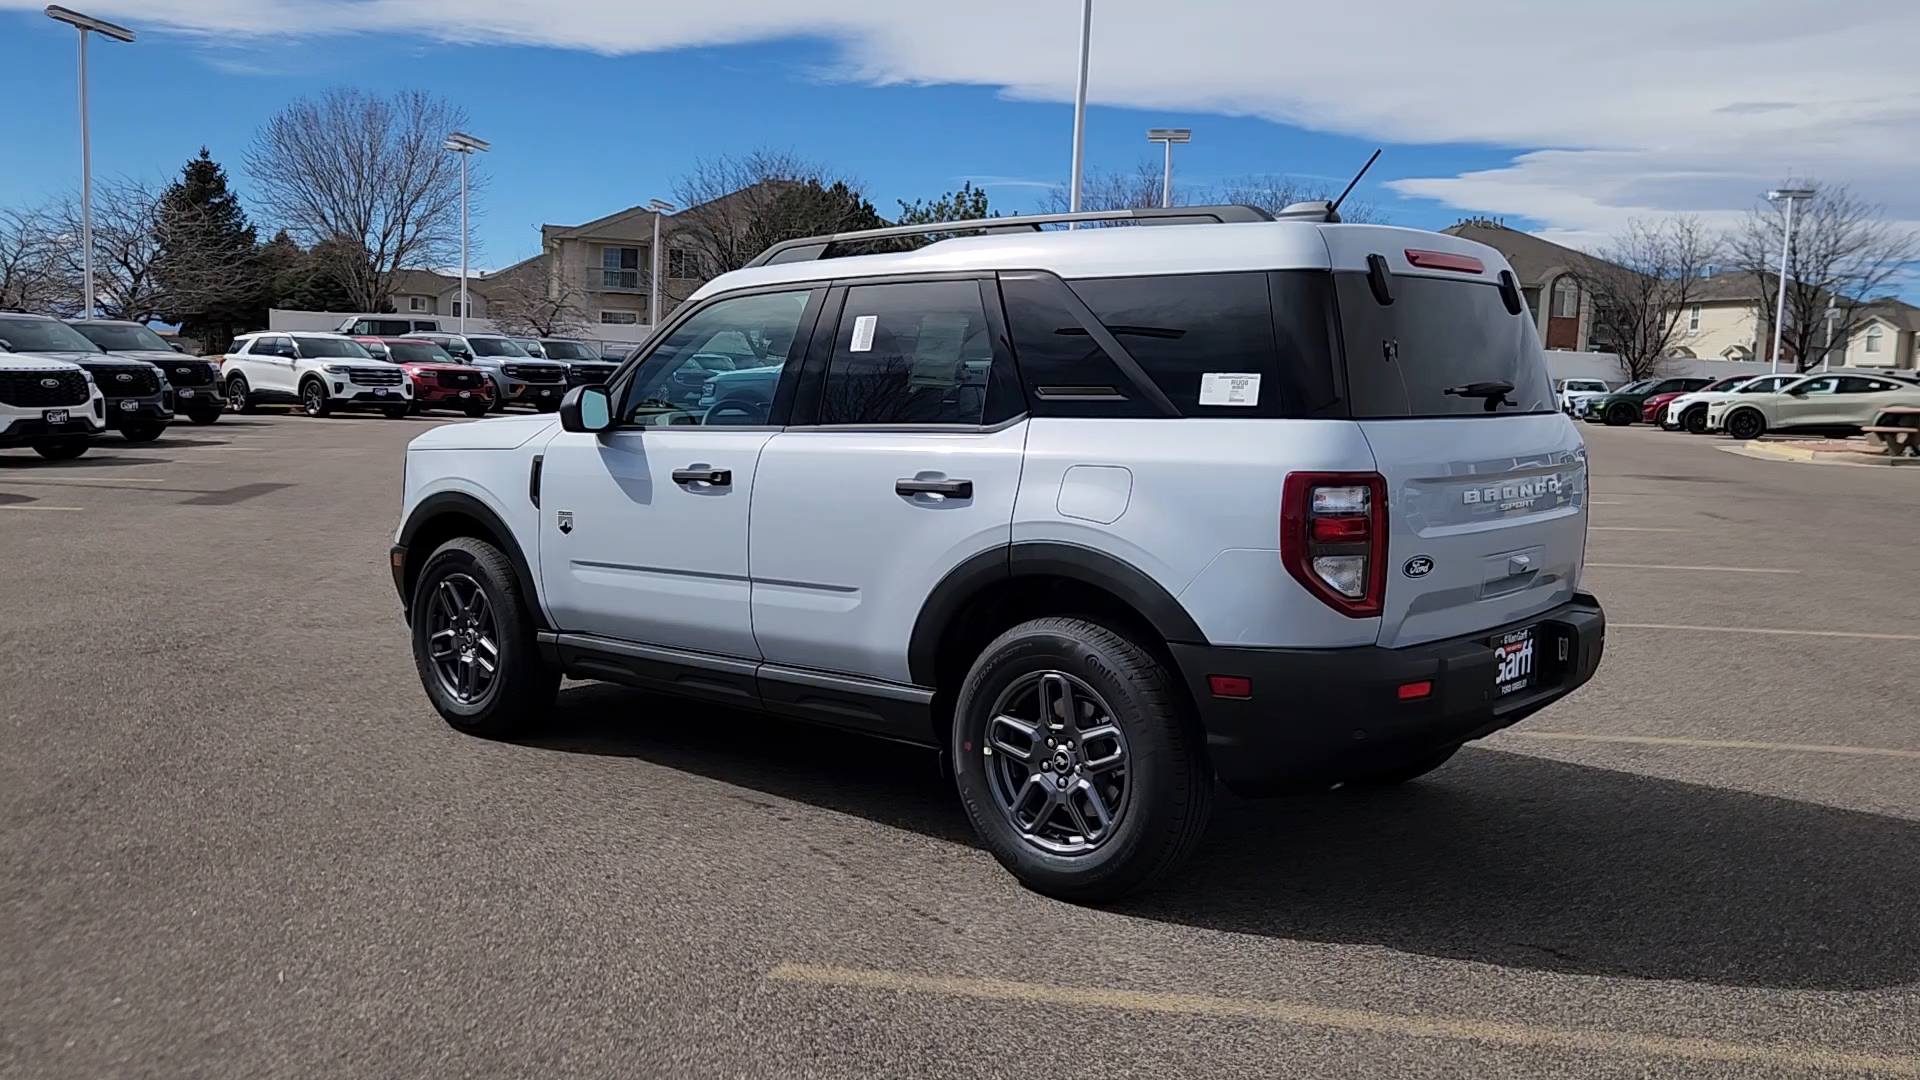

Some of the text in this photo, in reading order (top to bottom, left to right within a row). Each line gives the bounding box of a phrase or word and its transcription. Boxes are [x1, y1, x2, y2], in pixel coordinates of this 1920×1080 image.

[1463, 479, 1562, 505] BRONCO
[1500, 499, 1535, 511] SPORT
[1494, 638, 1534, 685] Garff
[1084, 653, 1146, 726] Continental
